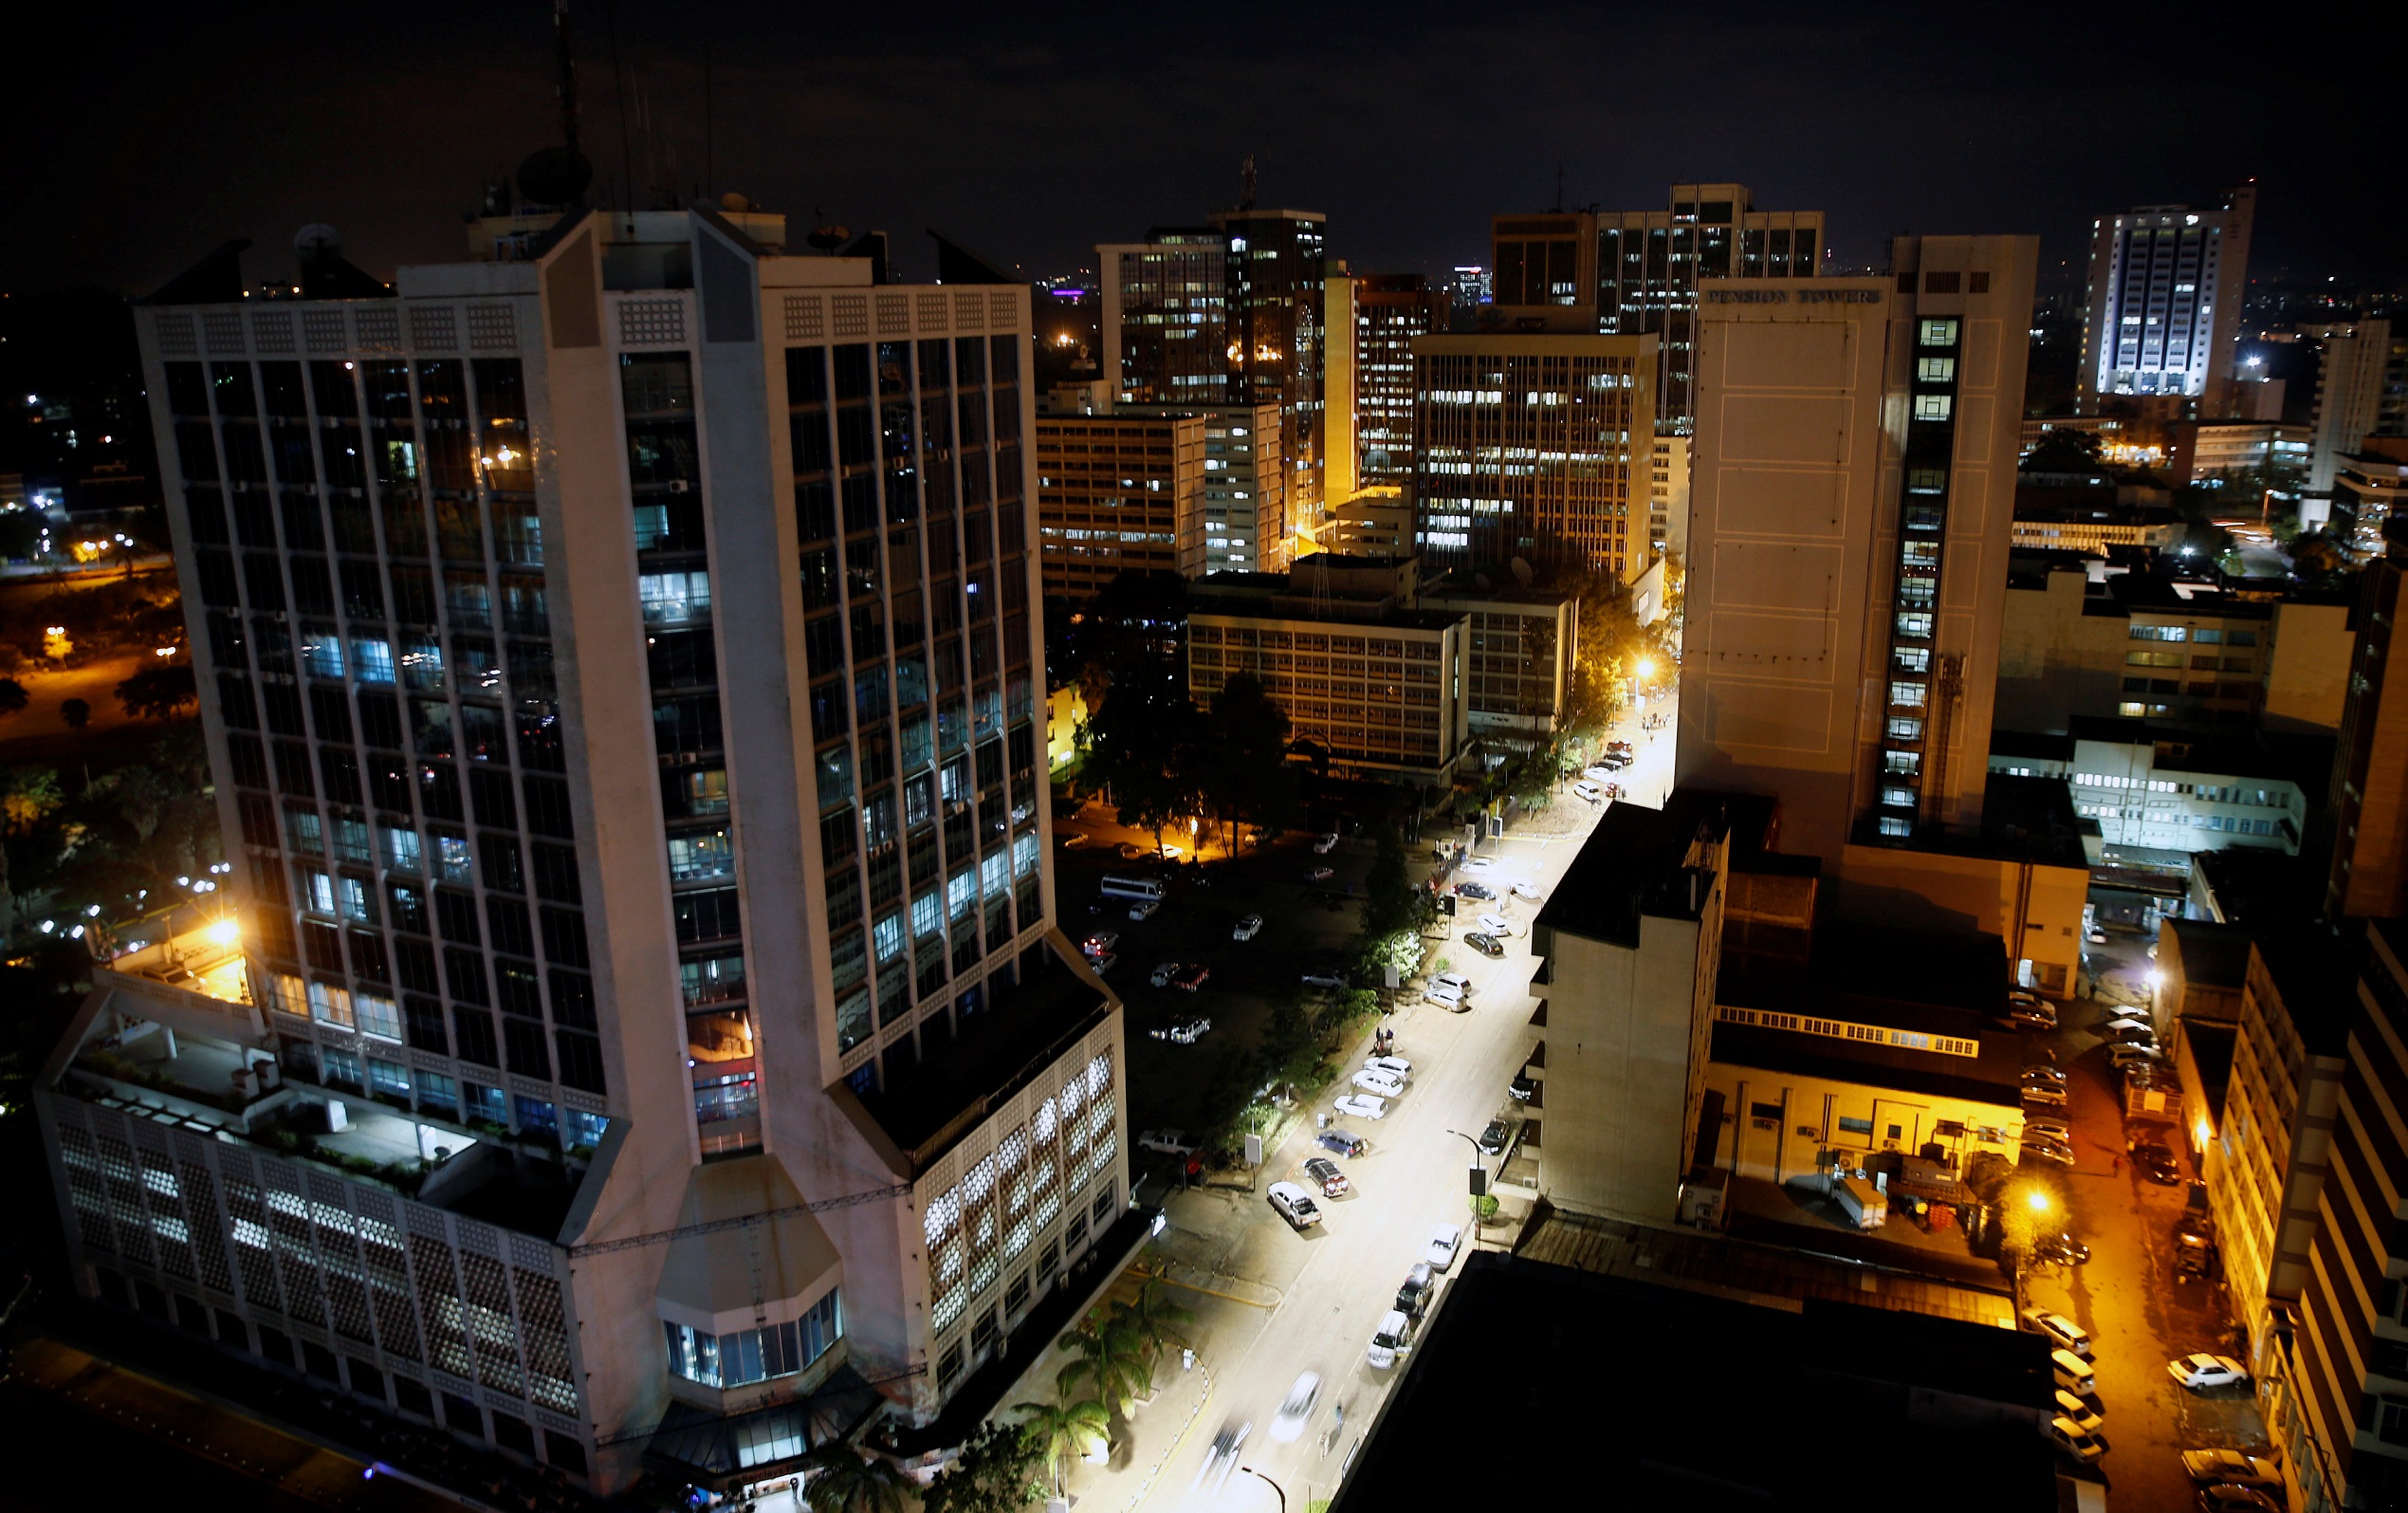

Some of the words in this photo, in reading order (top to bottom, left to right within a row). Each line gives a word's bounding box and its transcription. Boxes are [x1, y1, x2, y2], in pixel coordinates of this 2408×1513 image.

[1707, 289, 1788, 304] PENSION
[1798, 289, 1882, 304] TOWERS
[742, 1467, 783, 1483] Barclays
